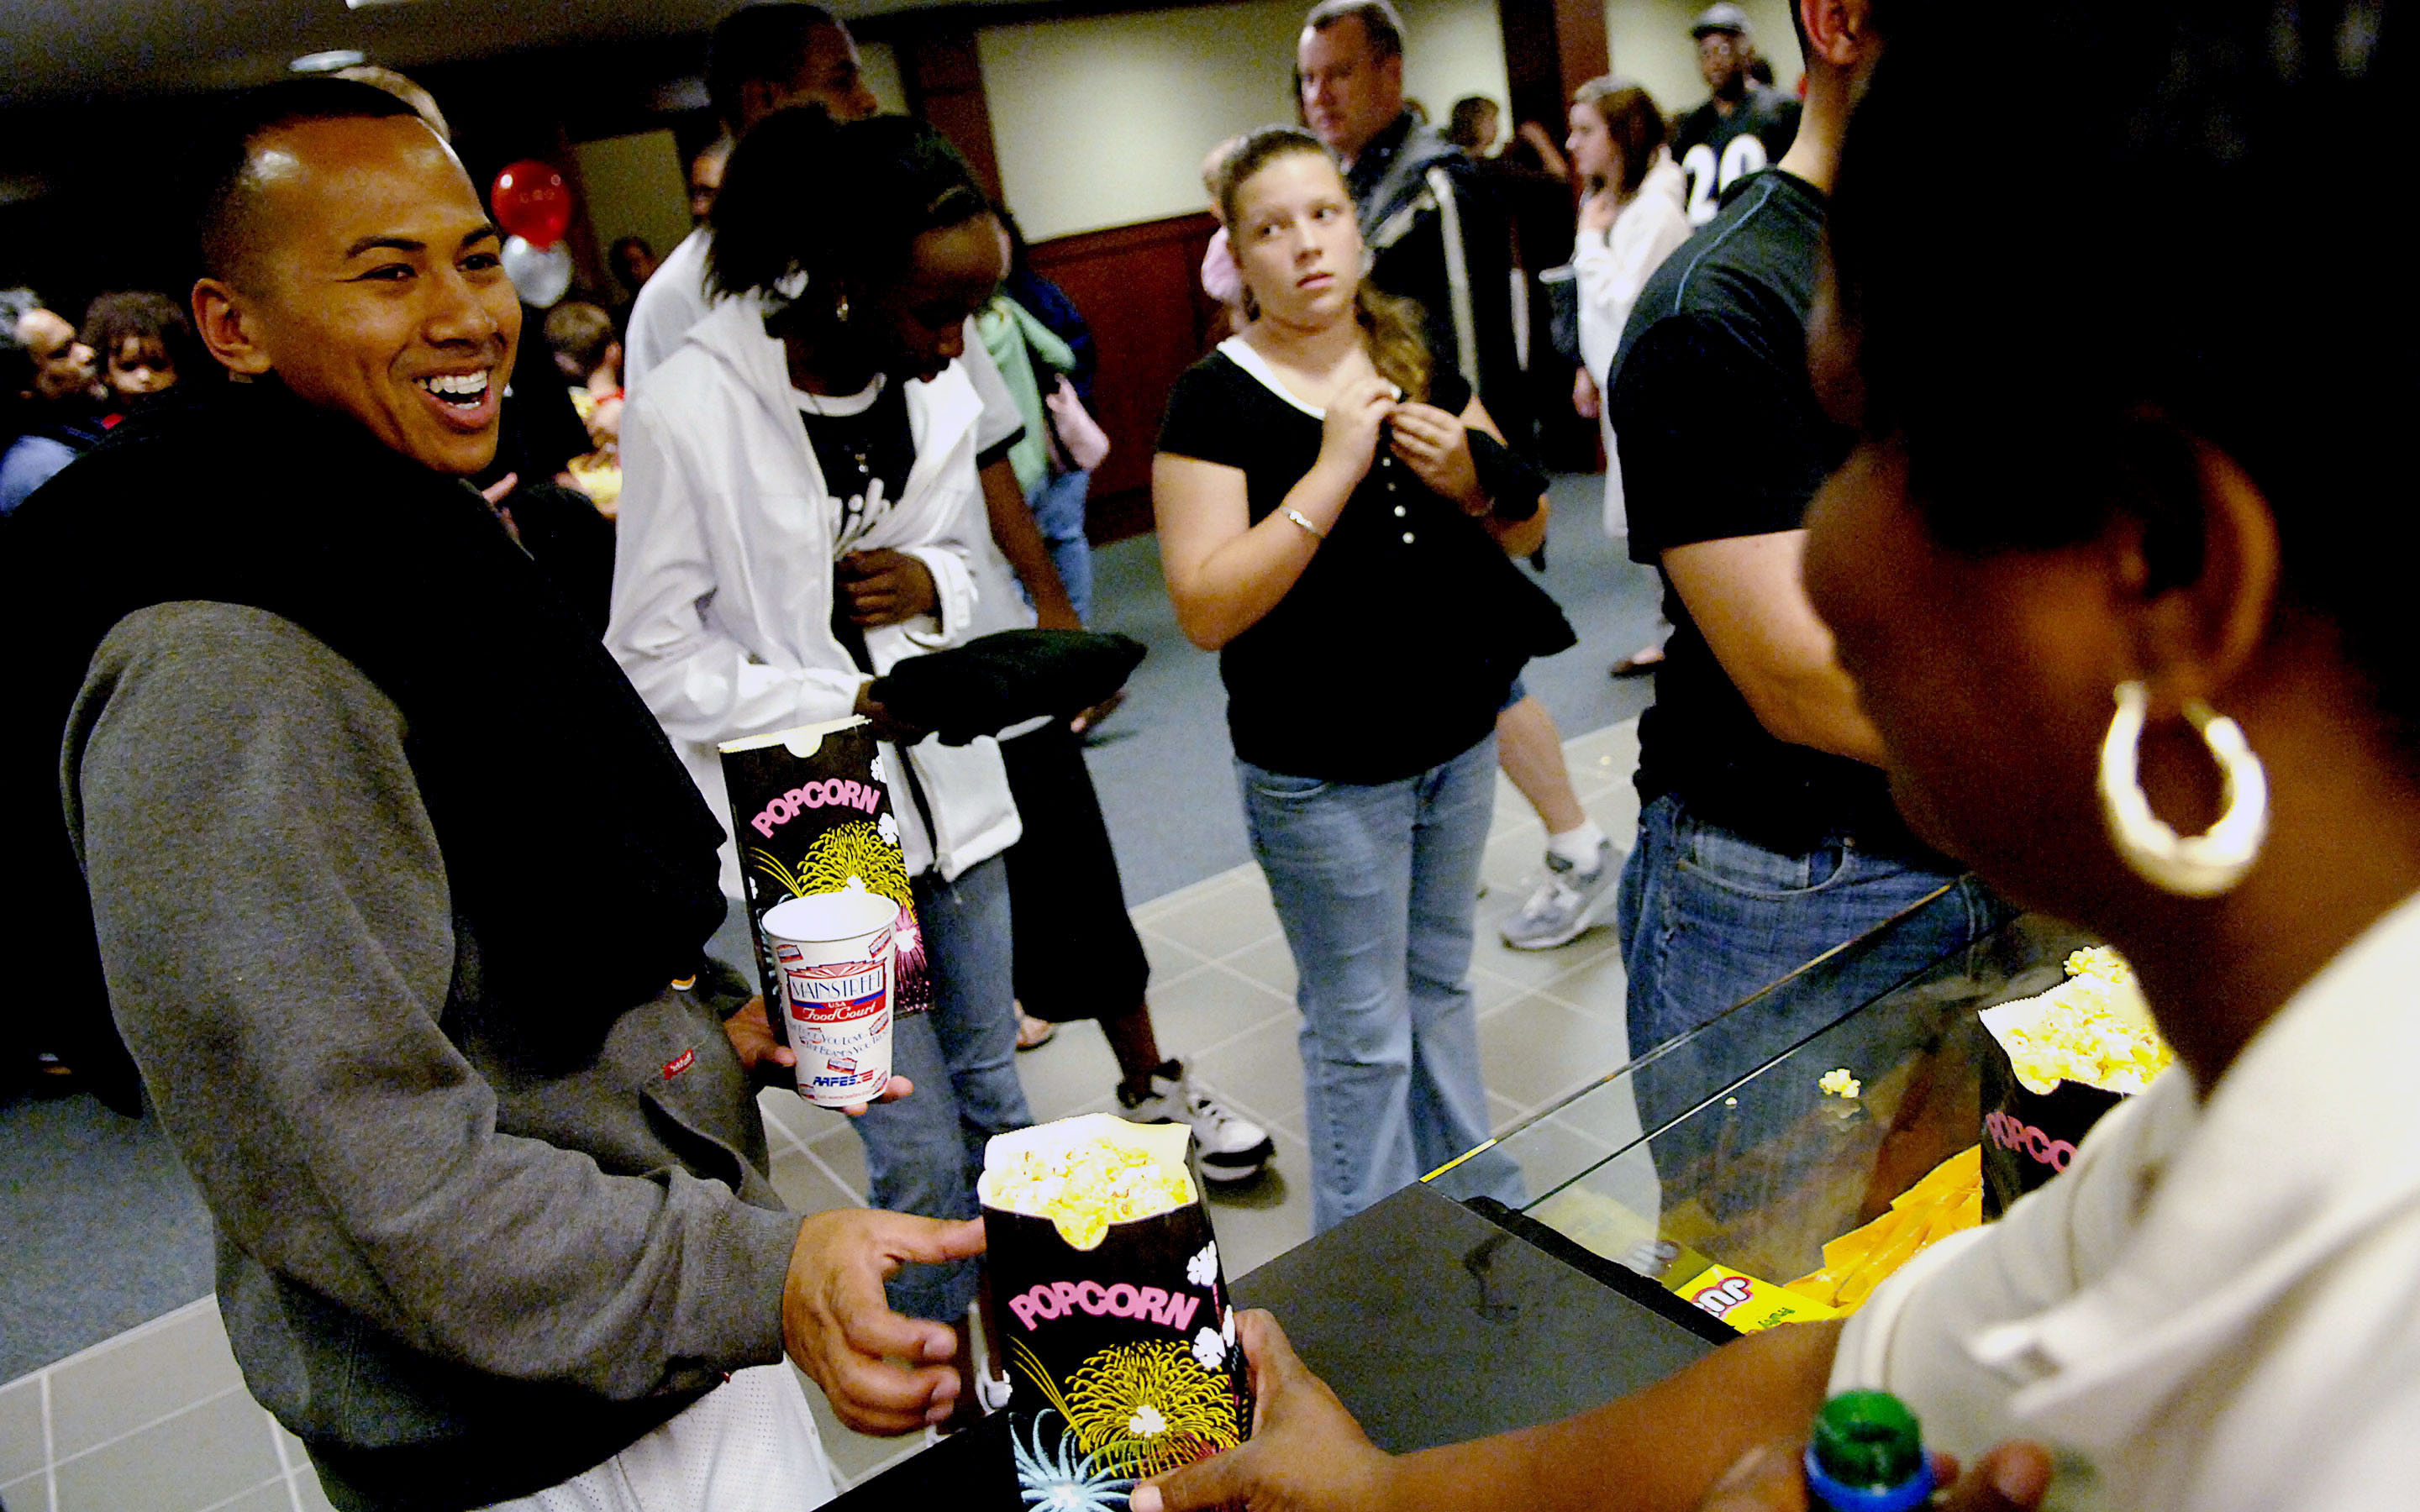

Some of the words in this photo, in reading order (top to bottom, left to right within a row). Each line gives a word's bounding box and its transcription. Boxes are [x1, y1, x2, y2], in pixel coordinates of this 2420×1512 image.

[1681, 133, 1767, 227] 20
[750, 778, 881, 838] POPCORN
[813, 1074, 858, 1087] AAFES
[1009, 1280, 1200, 1331] POPCORN
